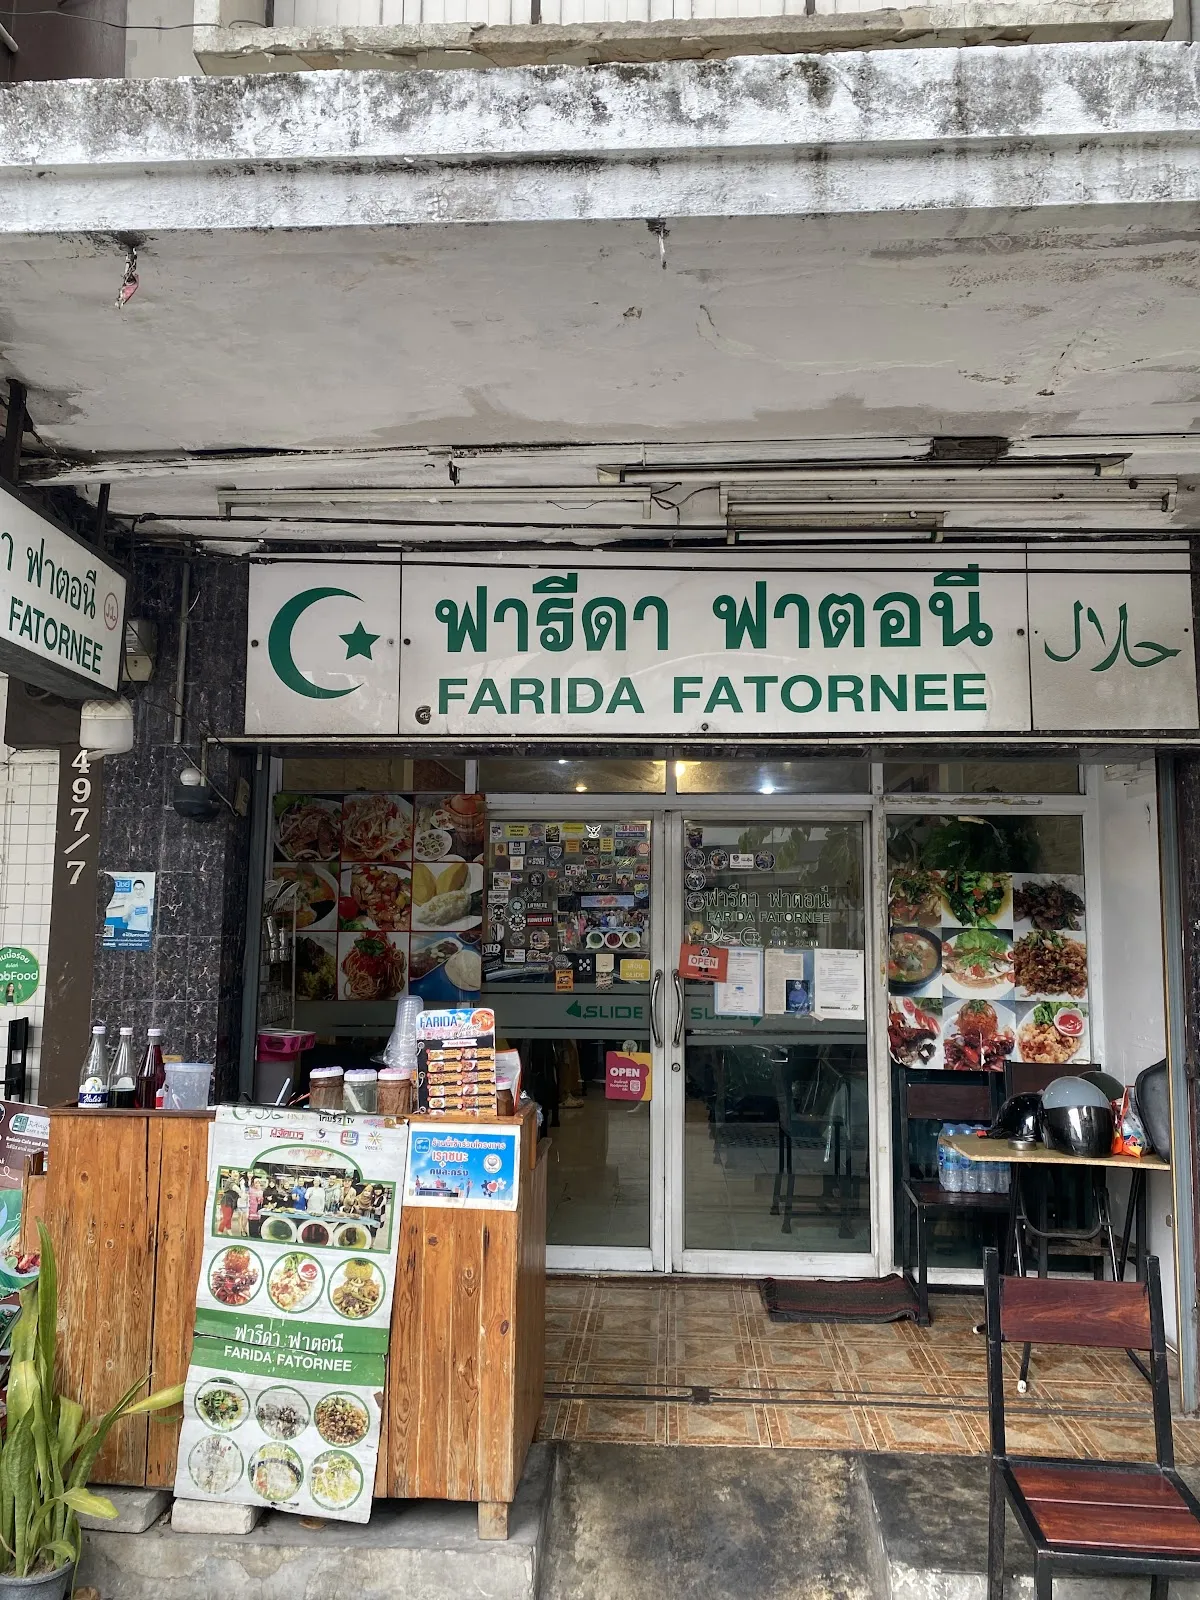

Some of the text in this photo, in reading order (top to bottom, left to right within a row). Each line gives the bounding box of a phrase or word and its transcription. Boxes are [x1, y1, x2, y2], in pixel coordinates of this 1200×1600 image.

[26, 538, 97, 620] ฟาตอนี
[435, 564, 993, 653] ฟารีดา ฟาตอนี
[9, 596, 103, 675] FATORNEE
[1043, 600, 1182, 672] حلال
[438, 673, 986, 715] FARIDA FATORNEE
[704, 883, 831, 909] ฟารีดา ฟาตอนี
[706, 911, 831, 923] FARIDA FATORNEE
[690, 956, 717, 967] OPEN
[420, 1015, 457, 1028] FARIDA
[587, 1006, 643, 1019] SLIDE
[610, 1067, 640, 1077] OPEN
[432, 1151, 469, 1162] เราชนะ
[234, 1324, 343, 1353] ฟารีดา ฟาตอนี
[224, 1345, 352, 1372] FARIDA FATORNEE
